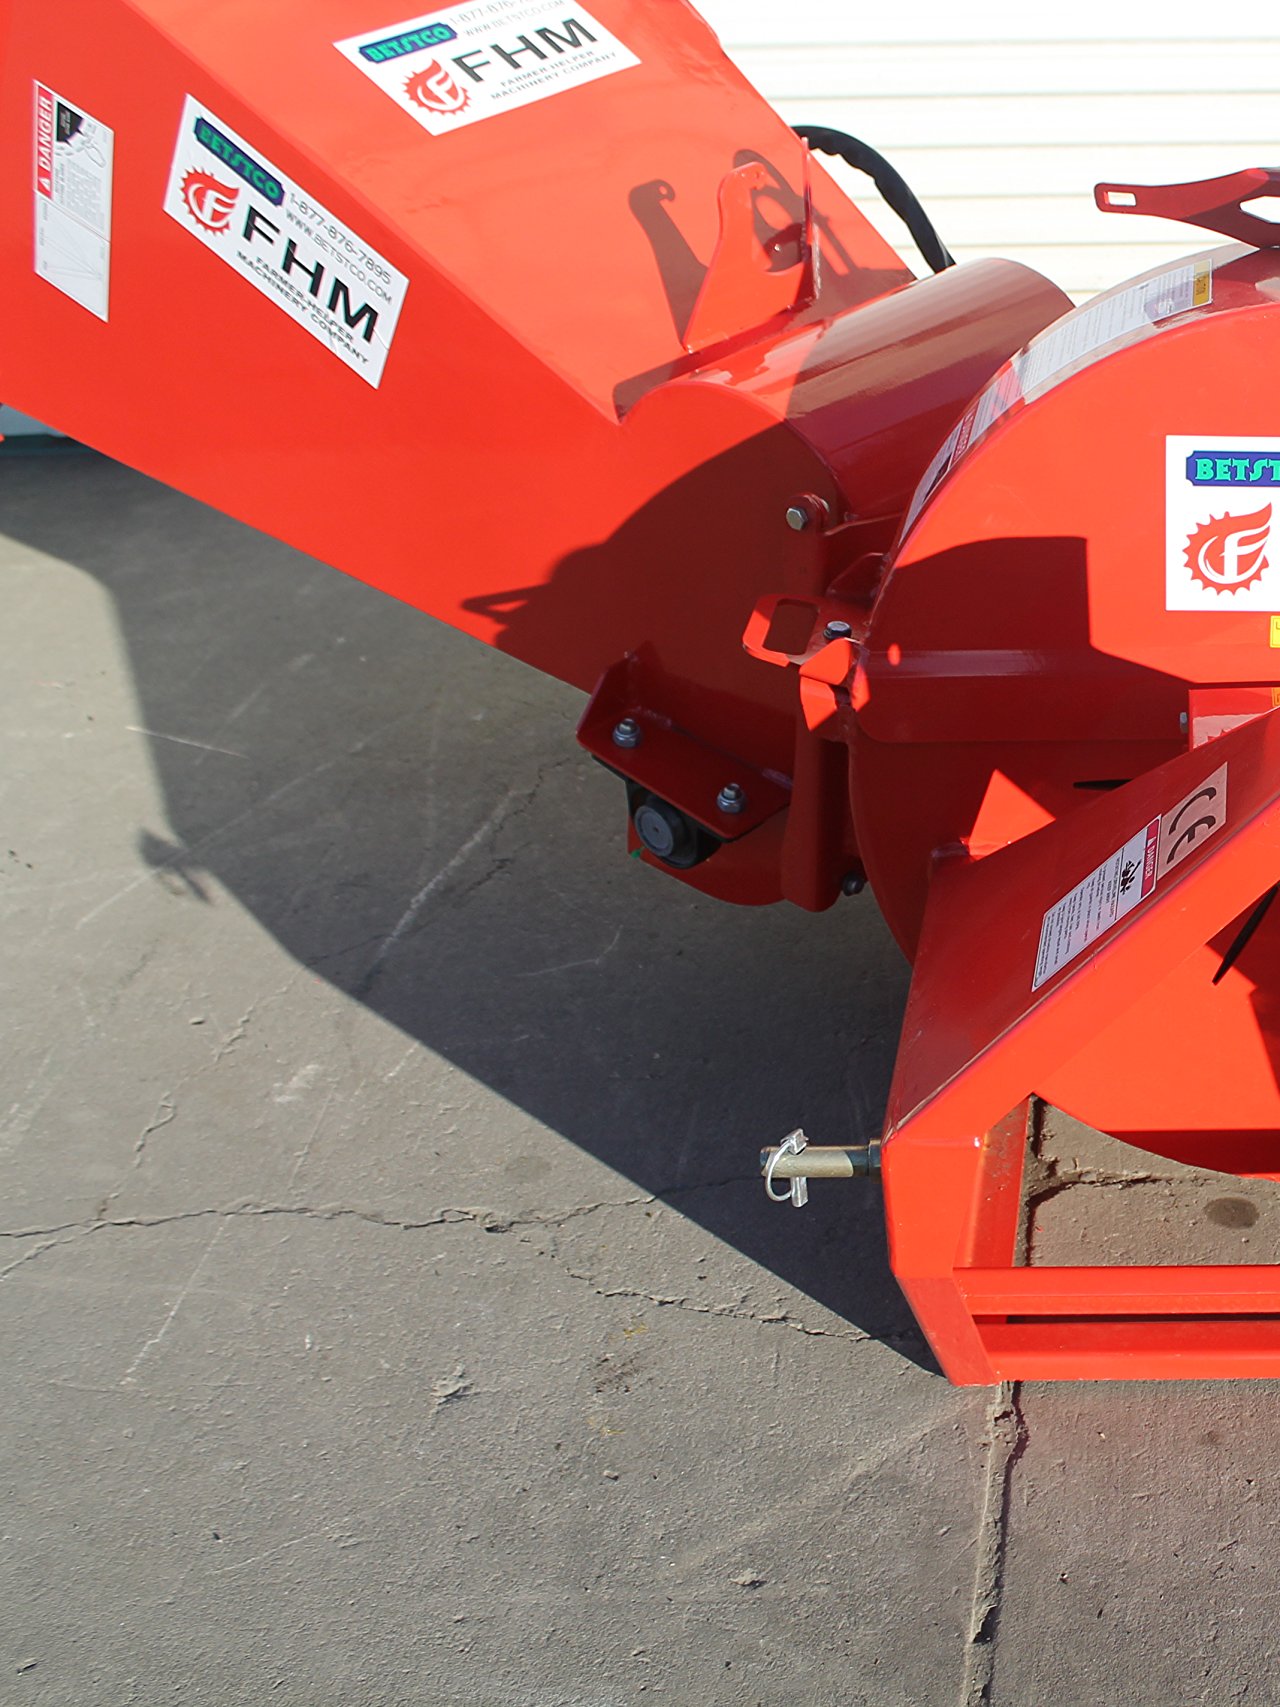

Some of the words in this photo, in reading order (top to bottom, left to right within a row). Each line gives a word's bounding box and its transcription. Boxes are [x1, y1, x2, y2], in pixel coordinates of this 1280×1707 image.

[363, 25, 451, 61] BETSTCO
[451, 18, 598, 83] FHM
[490, 71, 560, 100] MACHINERY
[562, 51, 617, 77] COMPANY
[38, 96, 52, 171] DANGER
[198, 123, 281, 201] BETSTCO
[243, 203, 379, 344] FHM
[285, 210, 393, 304] WWW.BETSTCO.COM
[289, 192, 392, 285] 1-877-876-7895
[236, 250, 308, 314] MACHINERY
[310, 313, 369, 365] COMPANY
[1144, 845, 1156, 880] DANGER
